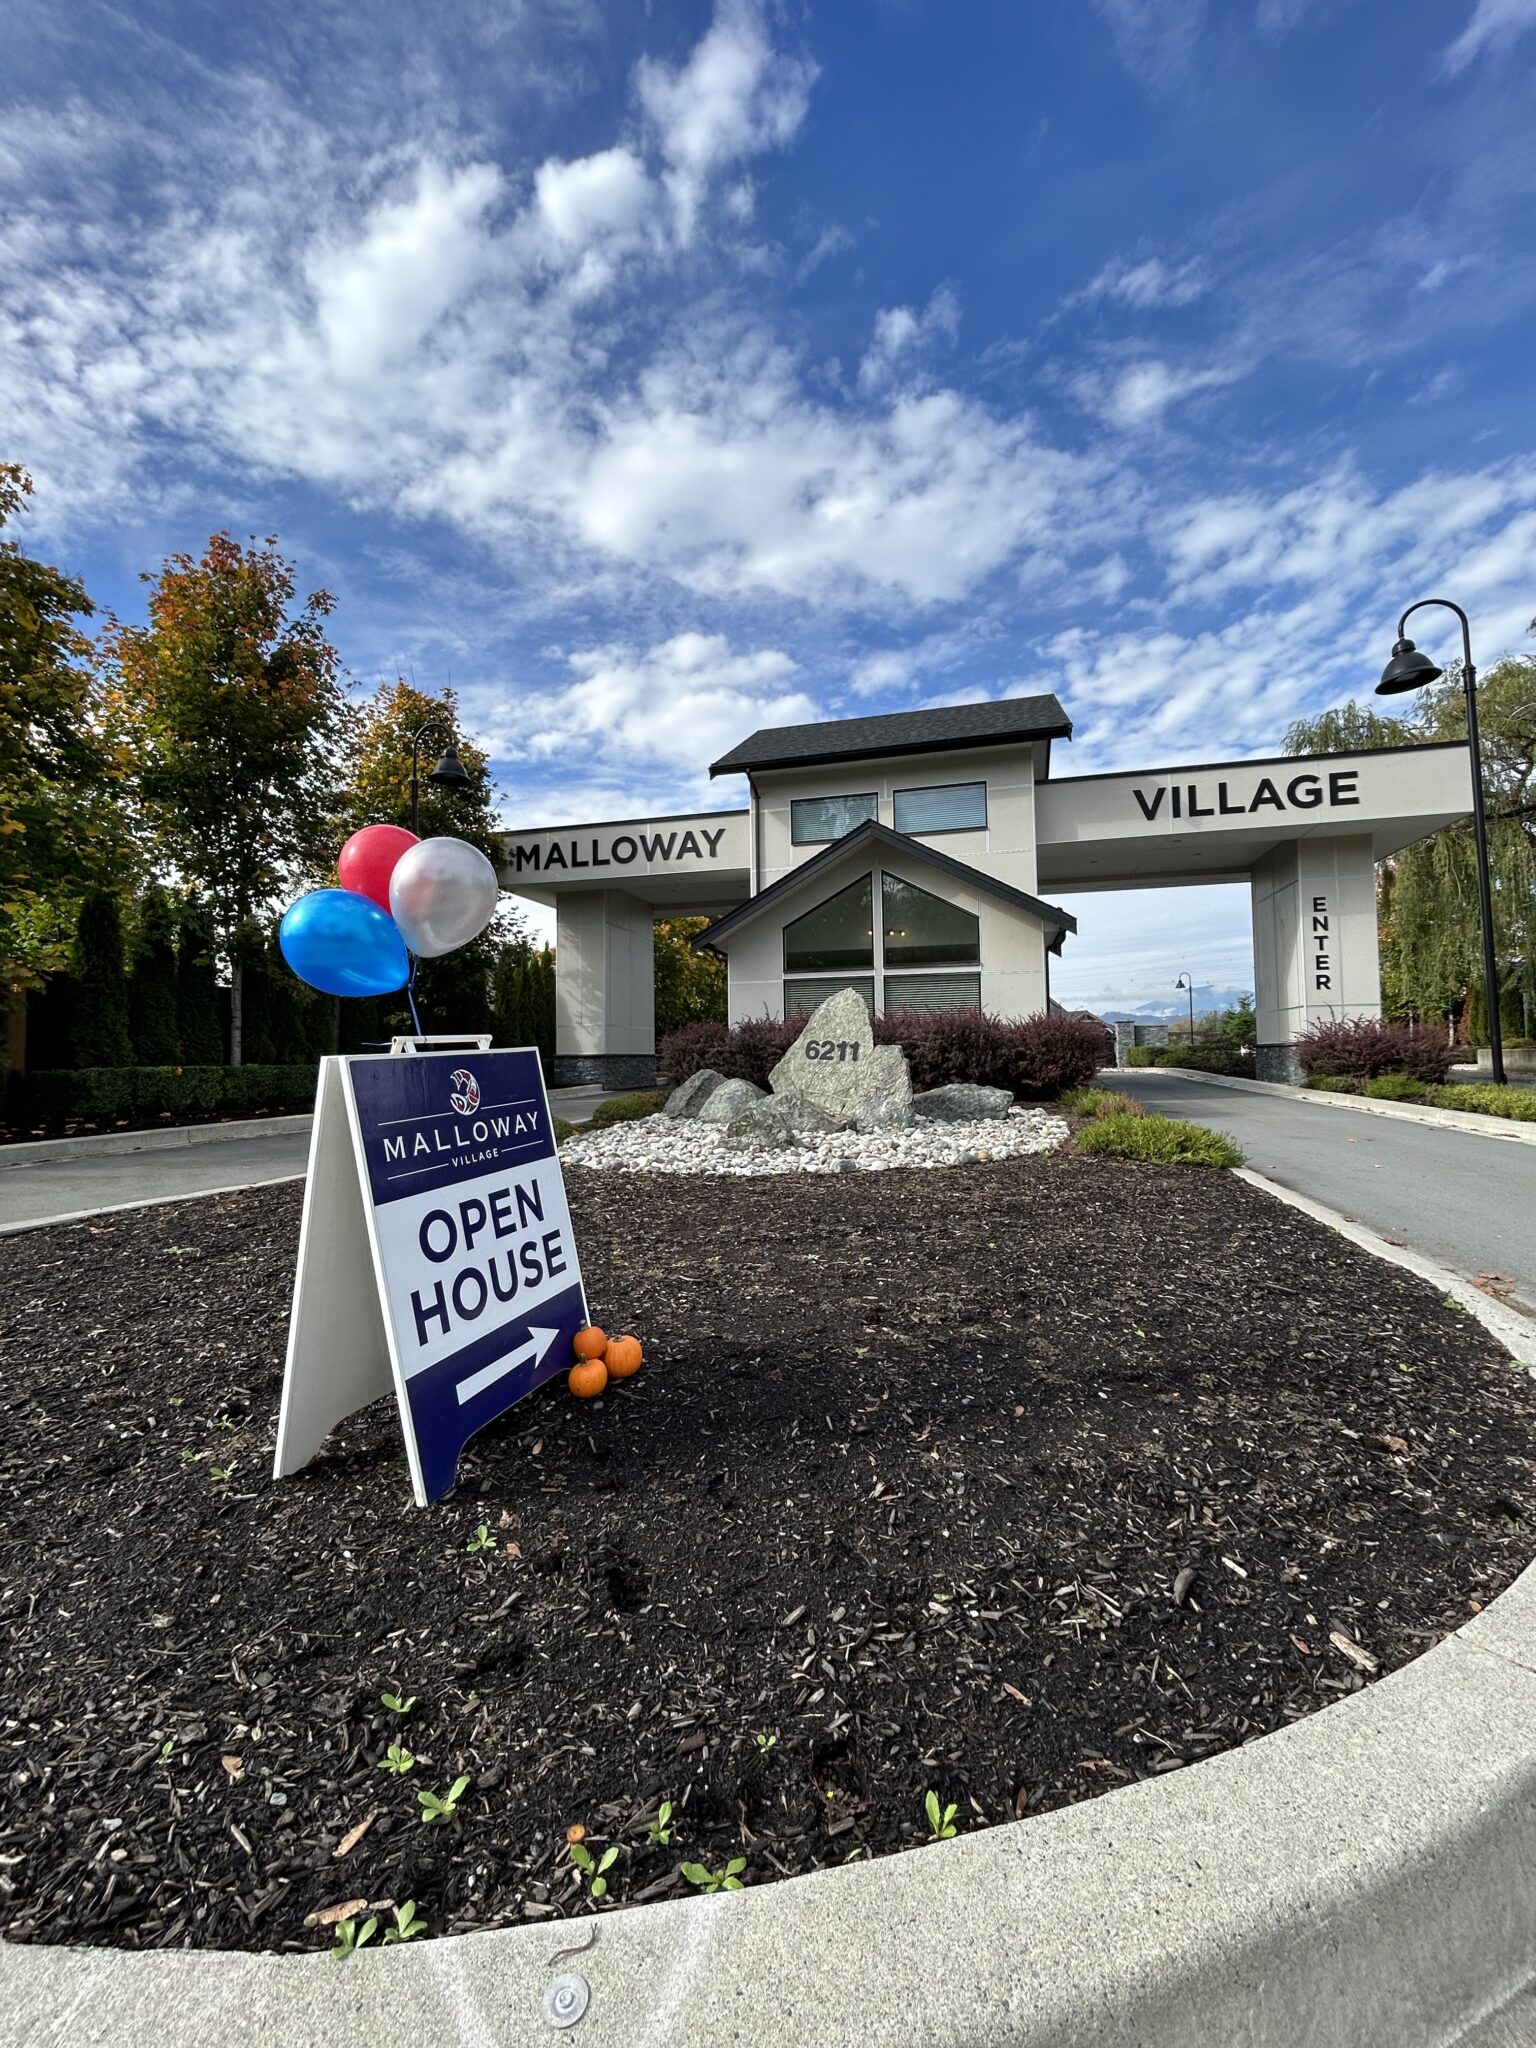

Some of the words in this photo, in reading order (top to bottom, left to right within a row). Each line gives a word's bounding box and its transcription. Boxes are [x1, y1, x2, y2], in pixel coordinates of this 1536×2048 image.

[1132, 770, 1360, 821] VILLAGE
[516, 828, 726, 872] MALLOWAY
[1312, 896, 1331, 990] ENTER
[805, 1040, 860, 1061] 6211
[383, 1111, 539, 1163] MALLOWAY
[451, 1147, 499, 1168] VILLAGE
[418, 1178, 545, 1263] OPEN
[410, 1228, 567, 1346] HOUSE
